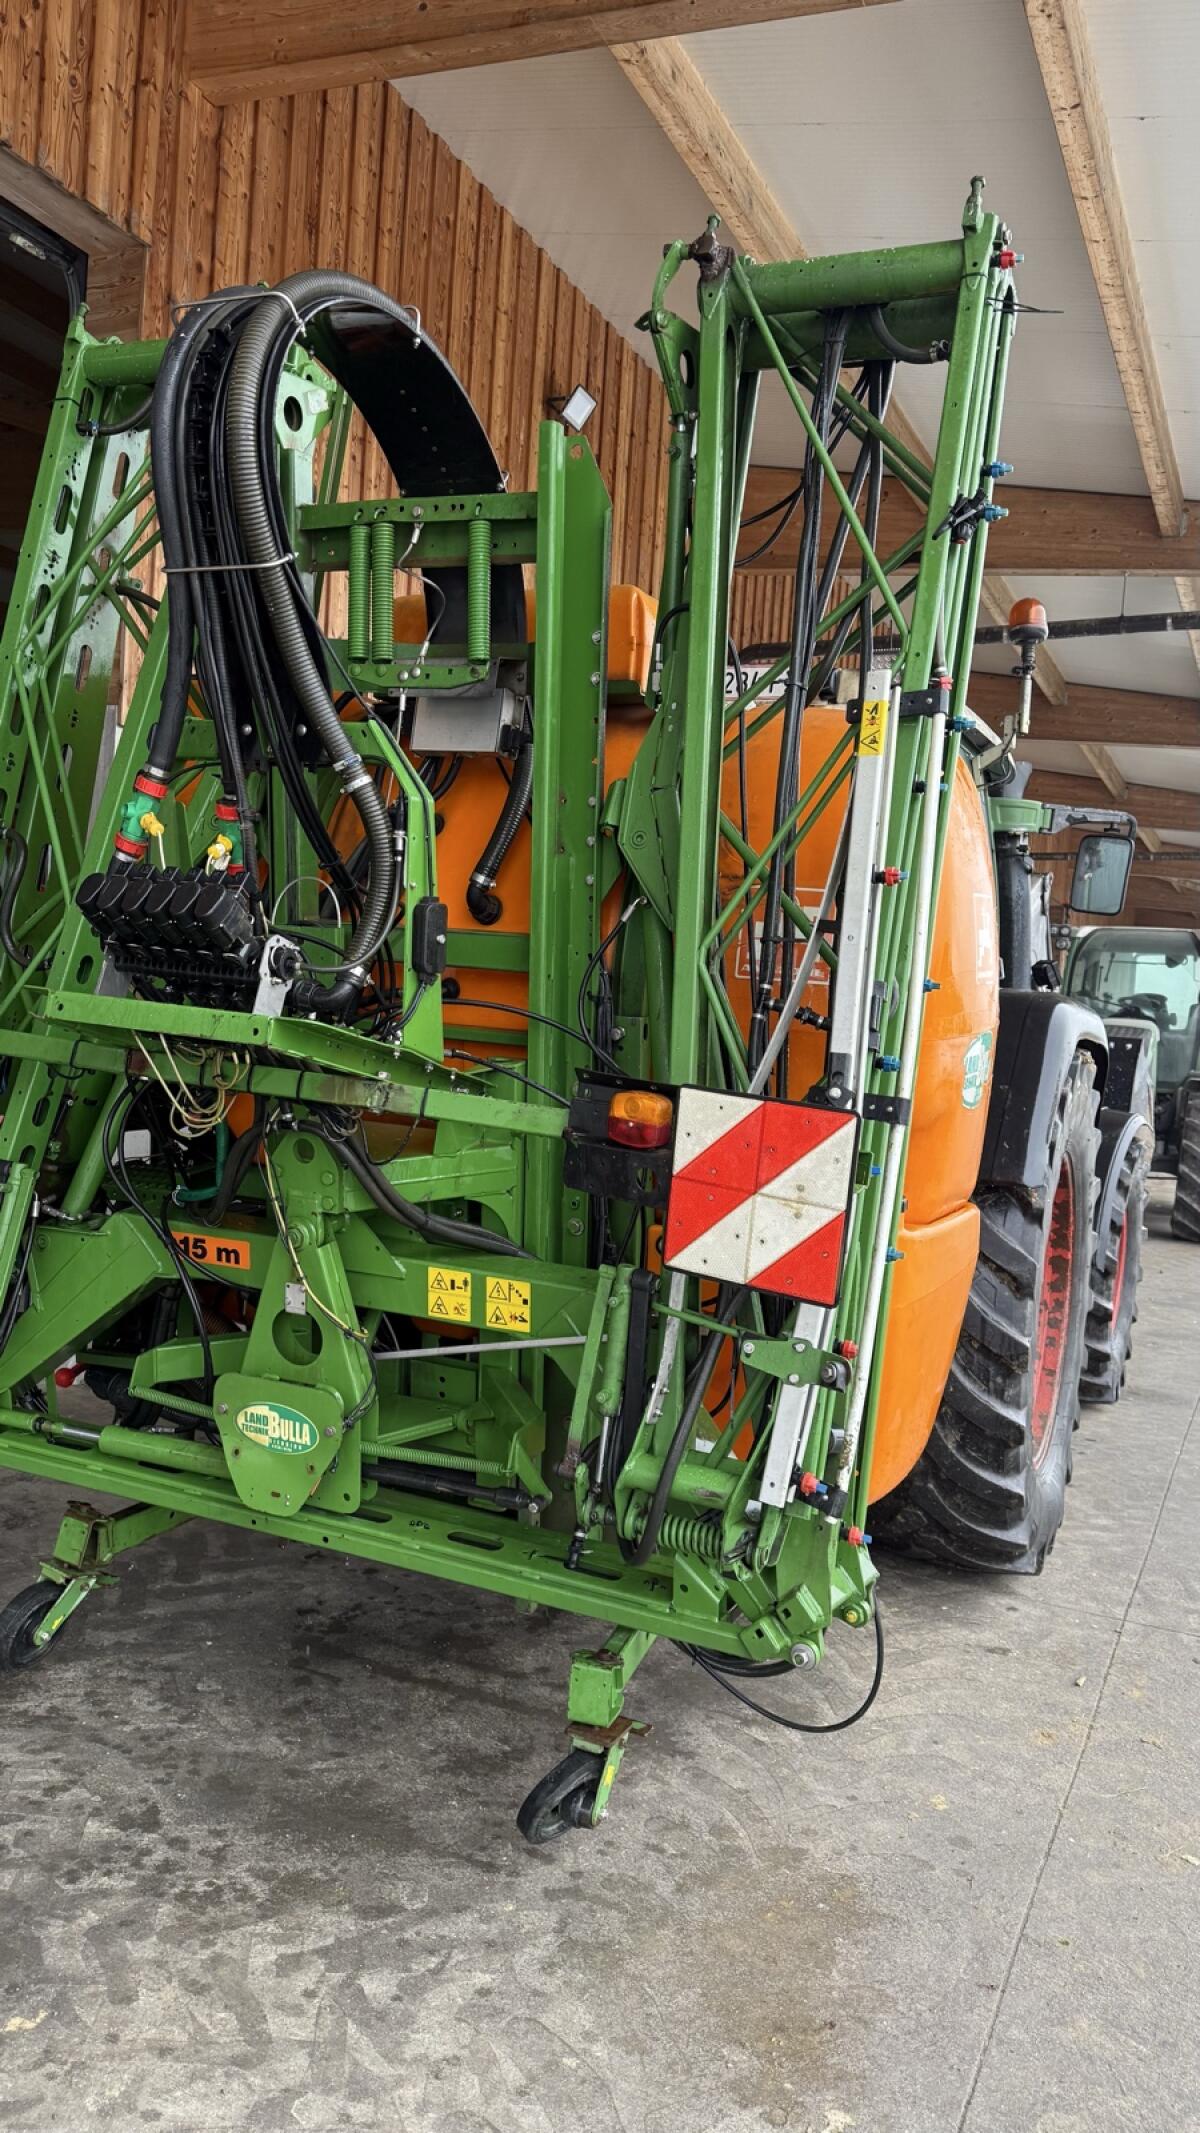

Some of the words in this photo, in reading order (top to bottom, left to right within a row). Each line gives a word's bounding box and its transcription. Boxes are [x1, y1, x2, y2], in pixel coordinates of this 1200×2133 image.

[179, 1235, 208, 1259] 15
[216, 1246, 240, 1265] m
[244, 1410, 269, 1427] LAND
[269, 1410, 312, 1446] BULLA
